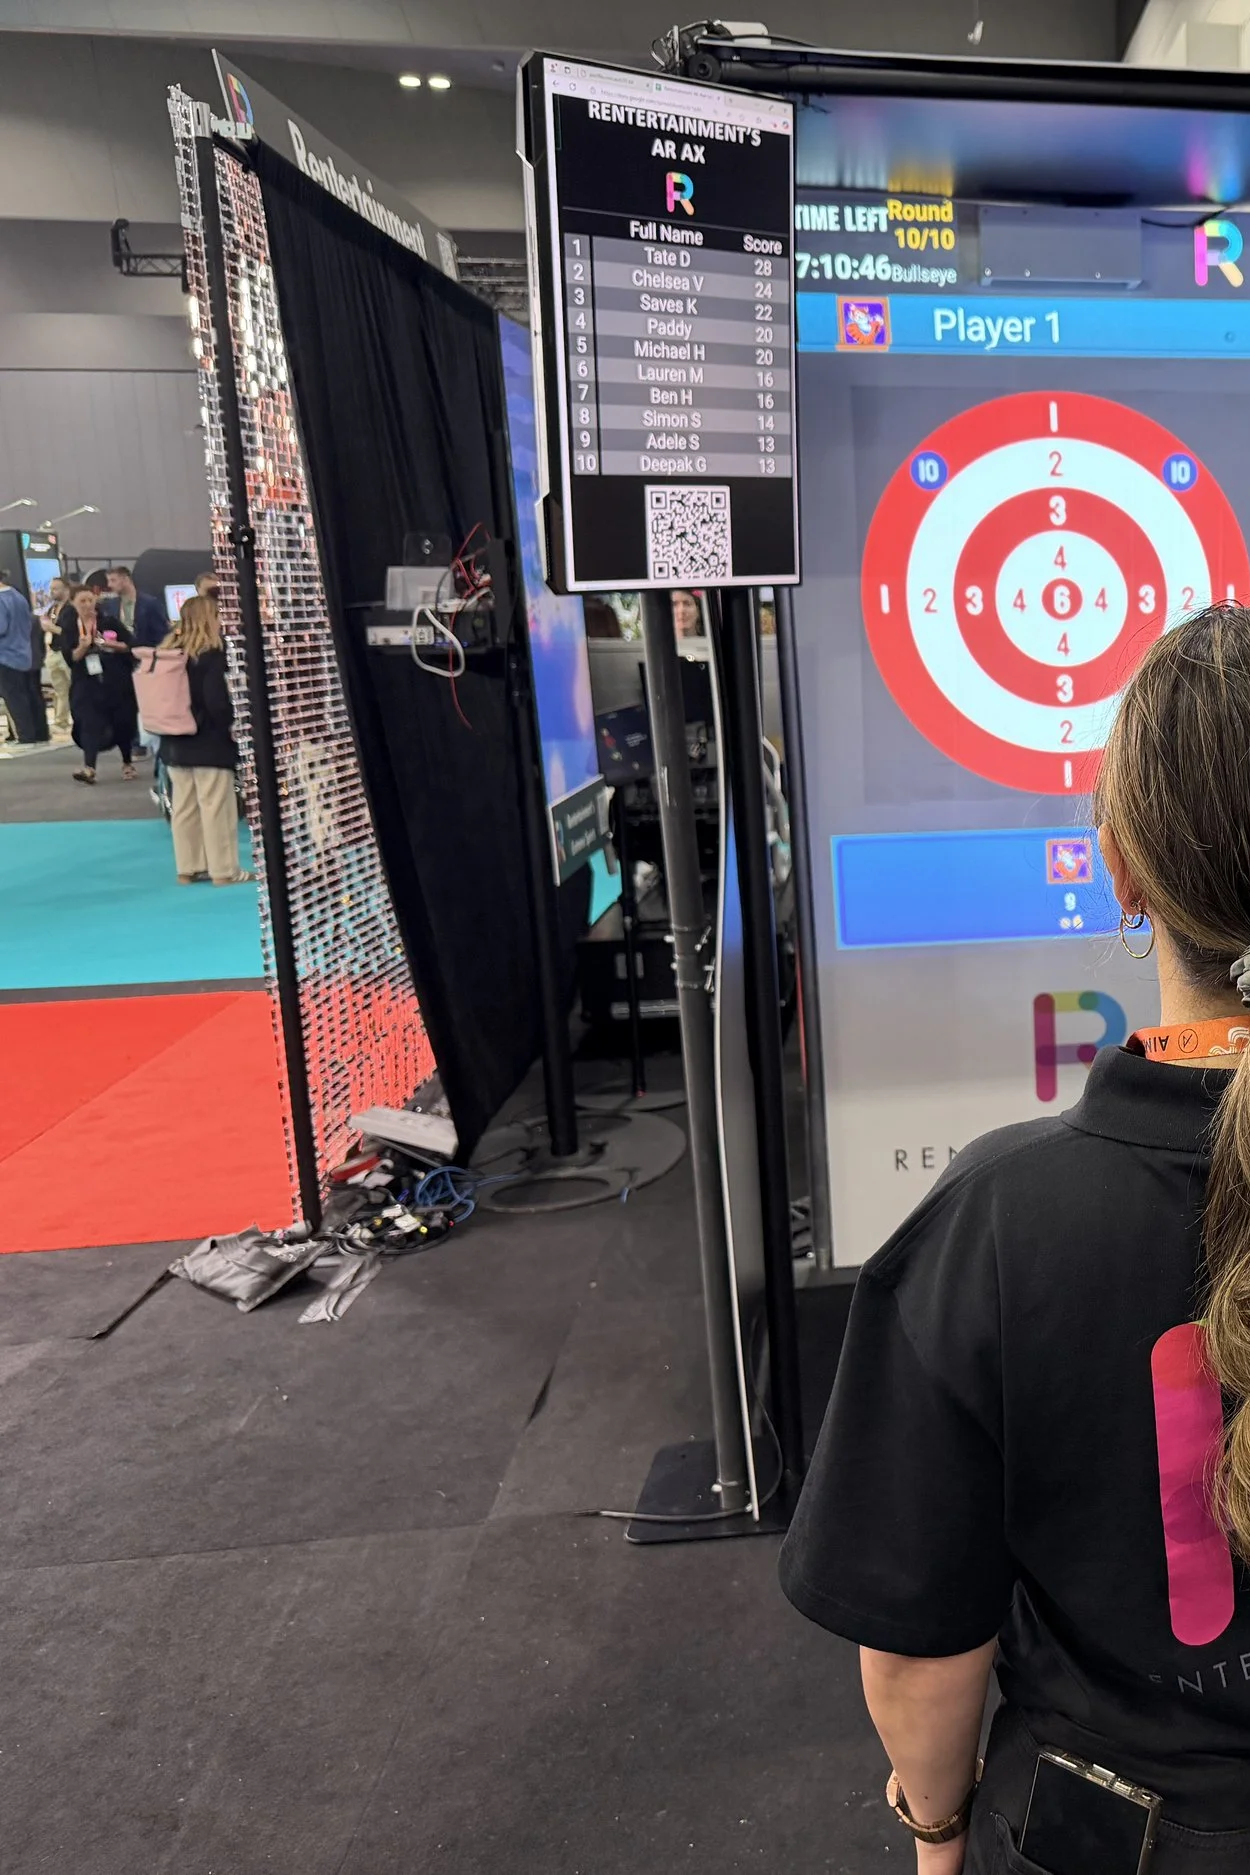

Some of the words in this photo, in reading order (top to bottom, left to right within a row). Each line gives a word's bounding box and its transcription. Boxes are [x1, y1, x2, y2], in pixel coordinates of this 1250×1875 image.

[588, 101, 762, 147] RENTERTAINMENT'S
[651, 138, 676, 160] AR
[680, 142, 706, 165] AX
[666, 171, 695, 216] R
[795, 204, 840, 231] TIME
[844, 206, 888, 232] LEFT
[886, 198, 953, 223] Round
[630, 220, 658, 241] Full
[660, 225, 704, 247] Name
[743, 234, 783, 256] Score
[894, 227, 956, 251] 10/10
[572, 239, 581, 256] 1
[644, 246, 677, 266] Tate
[679, 251, 691, 268] D
[753, 259, 772, 277] 28
[795, 252, 892, 281] 7:10:46
[1194, 219, 1244, 288] R
[573, 264, 585, 281] 2
[632, 270, 691, 291] Chelsea
[693, 276, 704, 292] V
[754, 282, 773, 299] 24
[891, 263, 957, 287] Bullseye
[574, 288, 585, 305] 3
[640, 294, 685, 314] Saves
[687, 298, 698, 315] K
[754, 305, 773, 321] 22
[575, 312, 587, 329] 4
[647, 318, 692, 340] Paddy
[755, 326, 773, 343] 20
[933, 308, 1035, 351] Player
[1045, 311, 1060, 344] 1
[576, 338, 587, 353] 5
[634, 341, 691, 360] Michael
[694, 344, 706, 361] H
[755, 349, 773, 365] 20
[577, 361, 588, 378] 6
[637, 364, 687, 382] Lauren
[689, 367, 704, 384] M
[757, 371, 774, 387] 16
[578, 384, 589, 401] 7
[650, 387, 679, 405] Ben
[681, 389, 693, 406] H
[757, 393, 774, 409] 16
[579, 408, 590, 425] 8
[642, 411, 689, 428] Simon
[691, 412, 702, 428] S
[758, 415, 775, 431] 14
[1049, 401, 1058, 433] 1
[580, 431, 591, 448] 9
[646, 433, 687, 450] Adele
[689, 434, 700, 450] S
[758, 436, 775, 453] 13
[577, 455, 596, 471] 10
[640, 455, 693, 475] Deepak
[695, 457, 707, 472] G
[759, 458, 776, 474] 13
[917, 458, 940, 484] 10
[1049, 450, 1063, 477] 2
[1170, 459, 1191, 485] 10
[1049, 494, 1067, 526] 3
[1053, 545, 1067, 571] 4
[879, 583, 891, 614] 1
[923, 588, 938, 613] 2
[965, 584, 984, 616] 3
[1012, 588, 1027, 614] 4
[1053, 584, 1071, 614] 6
[1095, 588, 1109, 612] 4
[1138, 584, 1156, 614] 3
[1181, 586, 1195, 610] 2
[1057, 631, 1070, 657] 4
[1055, 673, 1074, 704] 3
[1060, 720, 1074, 744] 2
[1064, 760, 1073, 789] 1
